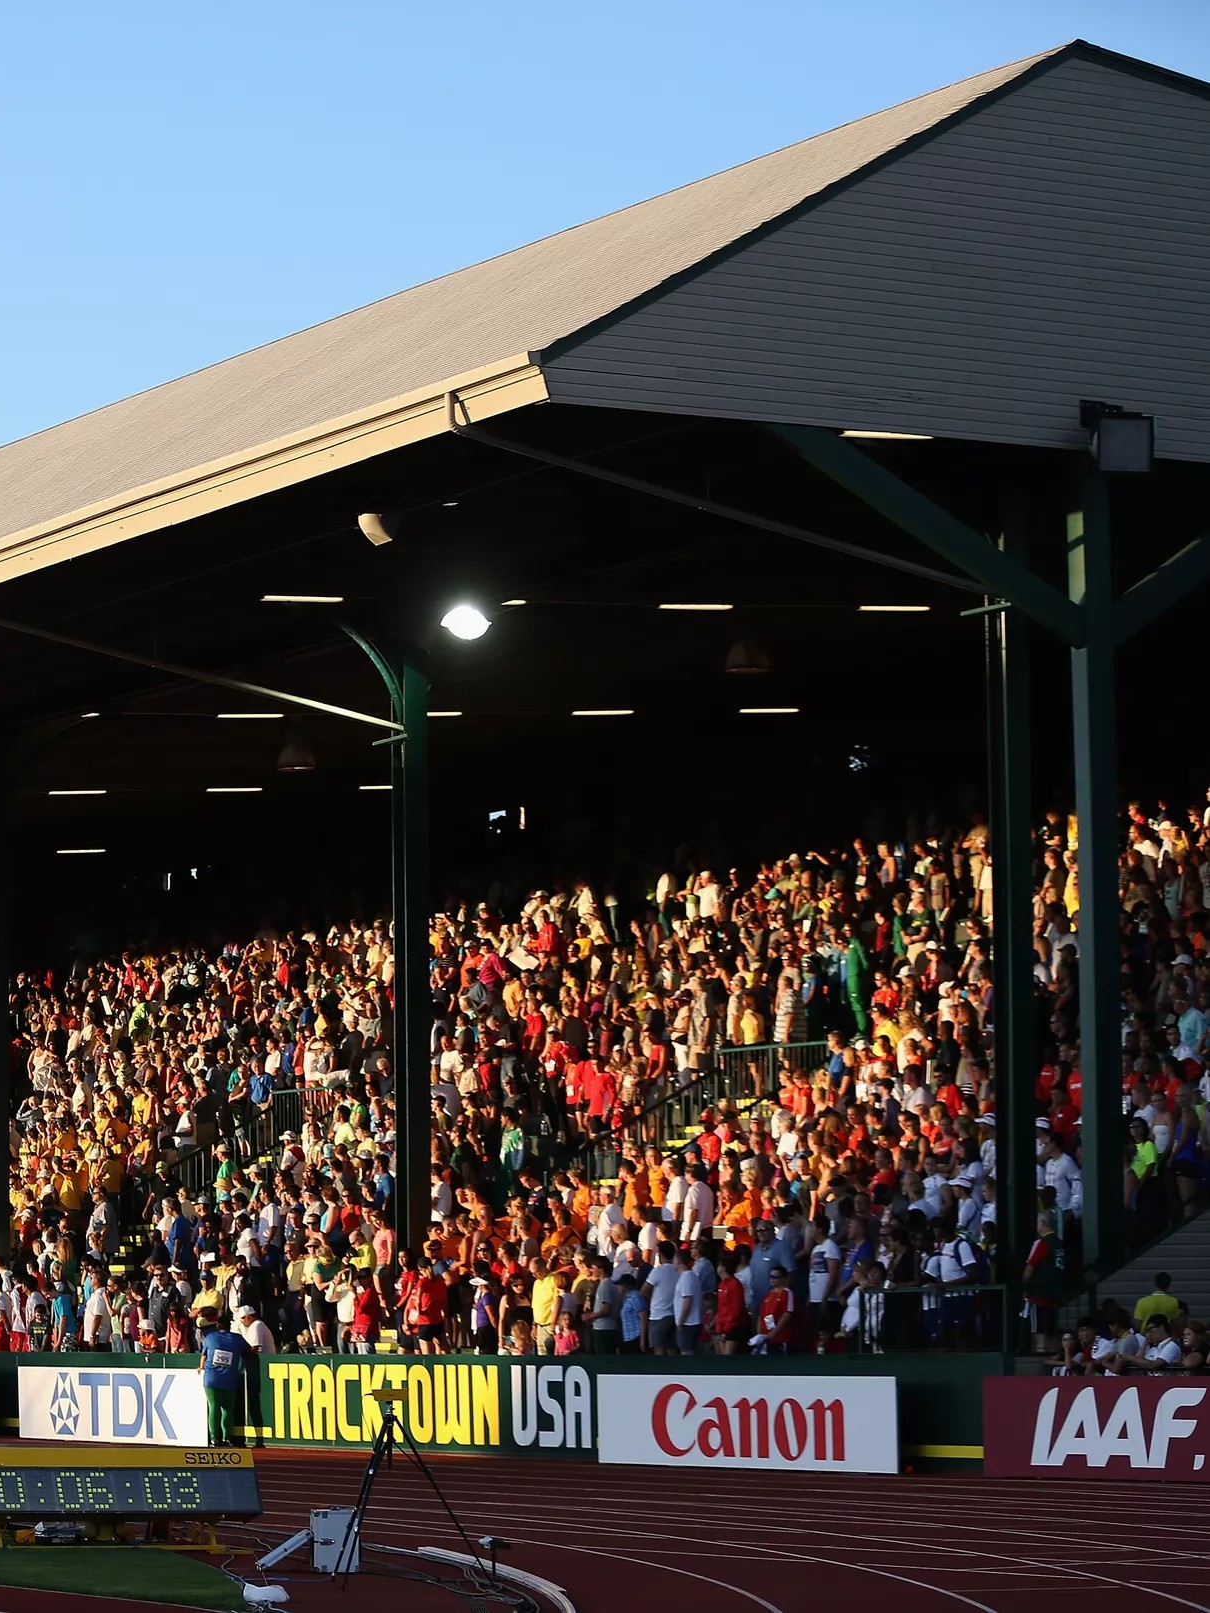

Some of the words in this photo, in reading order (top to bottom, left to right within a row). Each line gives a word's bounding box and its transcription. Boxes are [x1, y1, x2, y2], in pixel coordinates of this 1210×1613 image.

[78, 1372, 178, 1440] TDK
[268, 1363, 501, 1446] TRACKTOWN
[510, 1365, 593, 1449] USA
[651, 1383, 846, 1462] Canon
[184, 1452, 242, 1465] SEIKO
